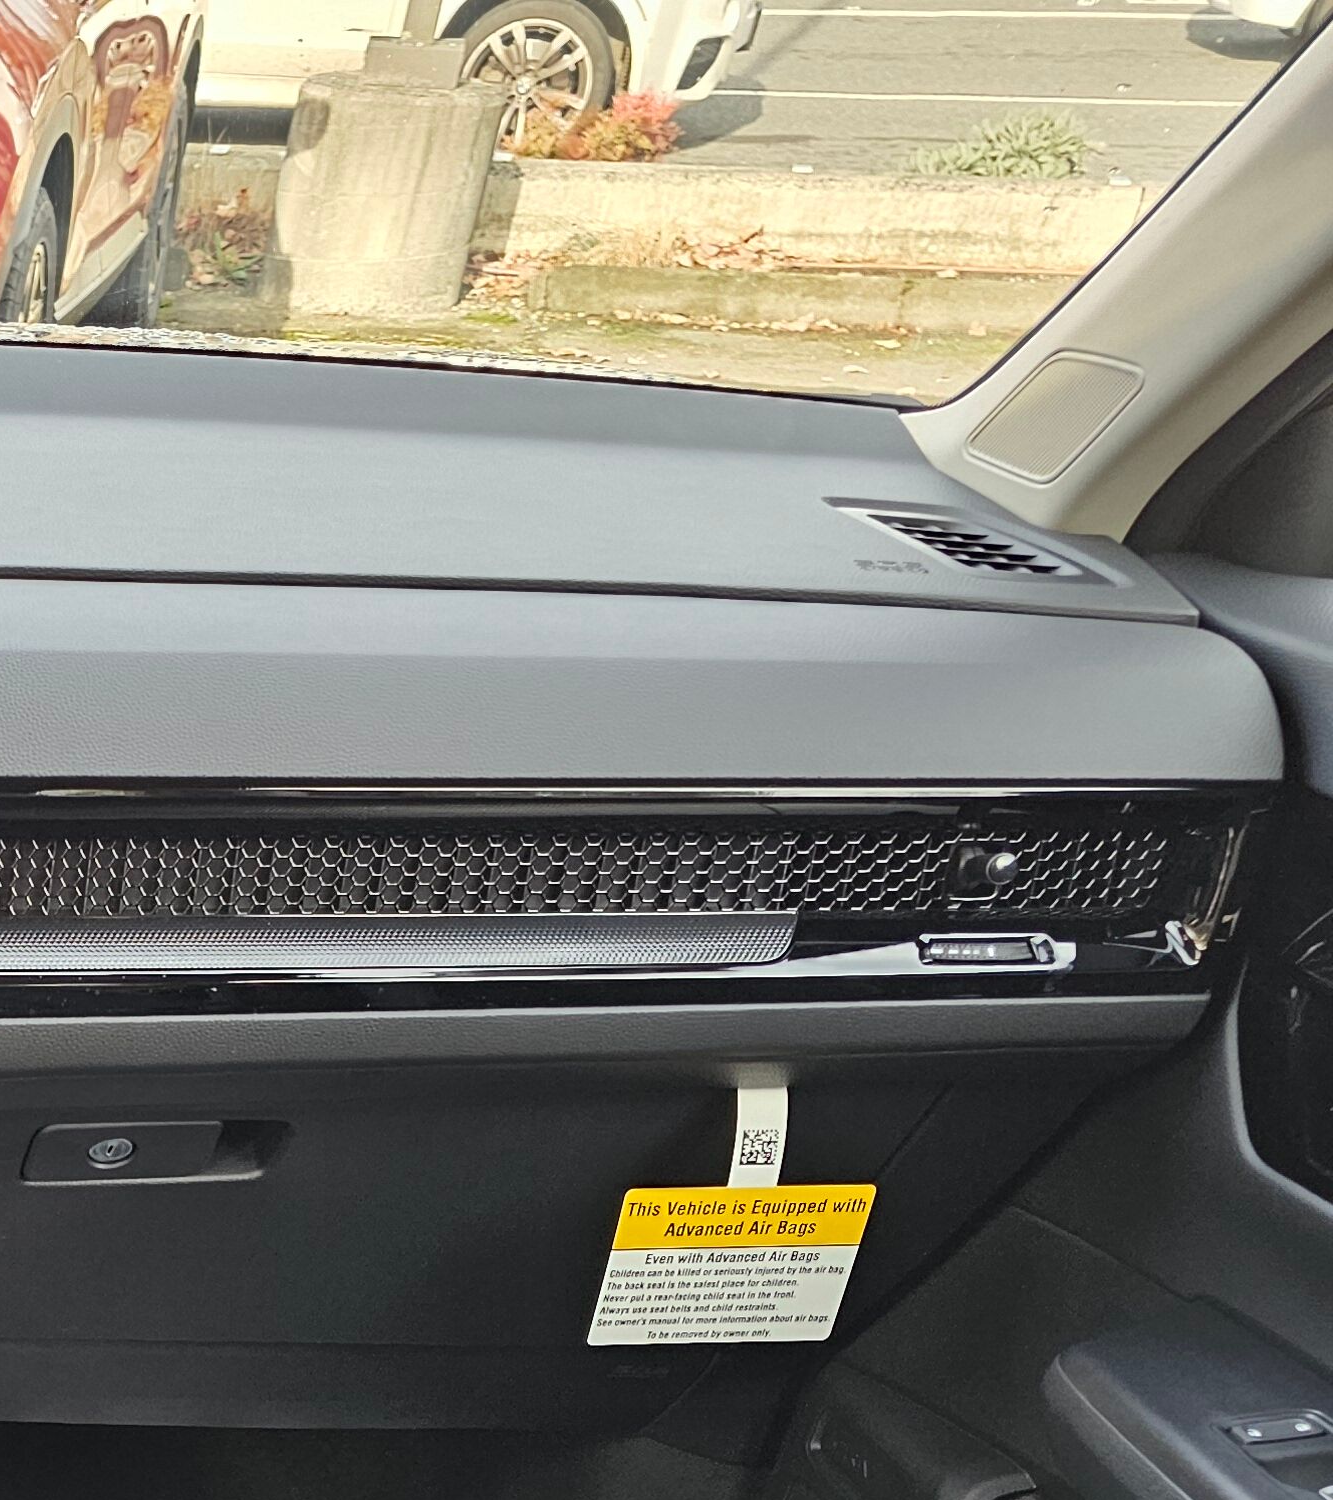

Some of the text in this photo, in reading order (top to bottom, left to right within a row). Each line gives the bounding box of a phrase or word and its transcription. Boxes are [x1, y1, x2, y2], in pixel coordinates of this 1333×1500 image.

[628, 1198, 867, 1217] This Vehicle is Equipped with
[664, 1220, 817, 1237] Advanced Air Bags
[645, 1251, 821, 1264] Even with Advanced Air Bags
[610, 1269, 645, 1278] Children
[665, 1269, 675, 1277] be
[677, 1268, 700, 1276] killed
[713, 1267, 752, 1276] seriously
[755, 1267, 785, 1276] injured
[787, 1267, 796, 1275] by
[799, 1266, 812, 1274] the
[828, 1266, 846, 1275] bag.
[607, 1282, 621, 1290] The
[667, 1281, 675, 1289] is
[694, 1280, 720, 1288] safest
[721, 1281, 745, 1289] place
[600, 1307, 629, 1315] Always
[735, 1303, 778, 1311] restraints.
[647, 1331, 656, 1339] To
[711, 1330, 721, 1339] by
[751, 1329, 771, 1337] only.
